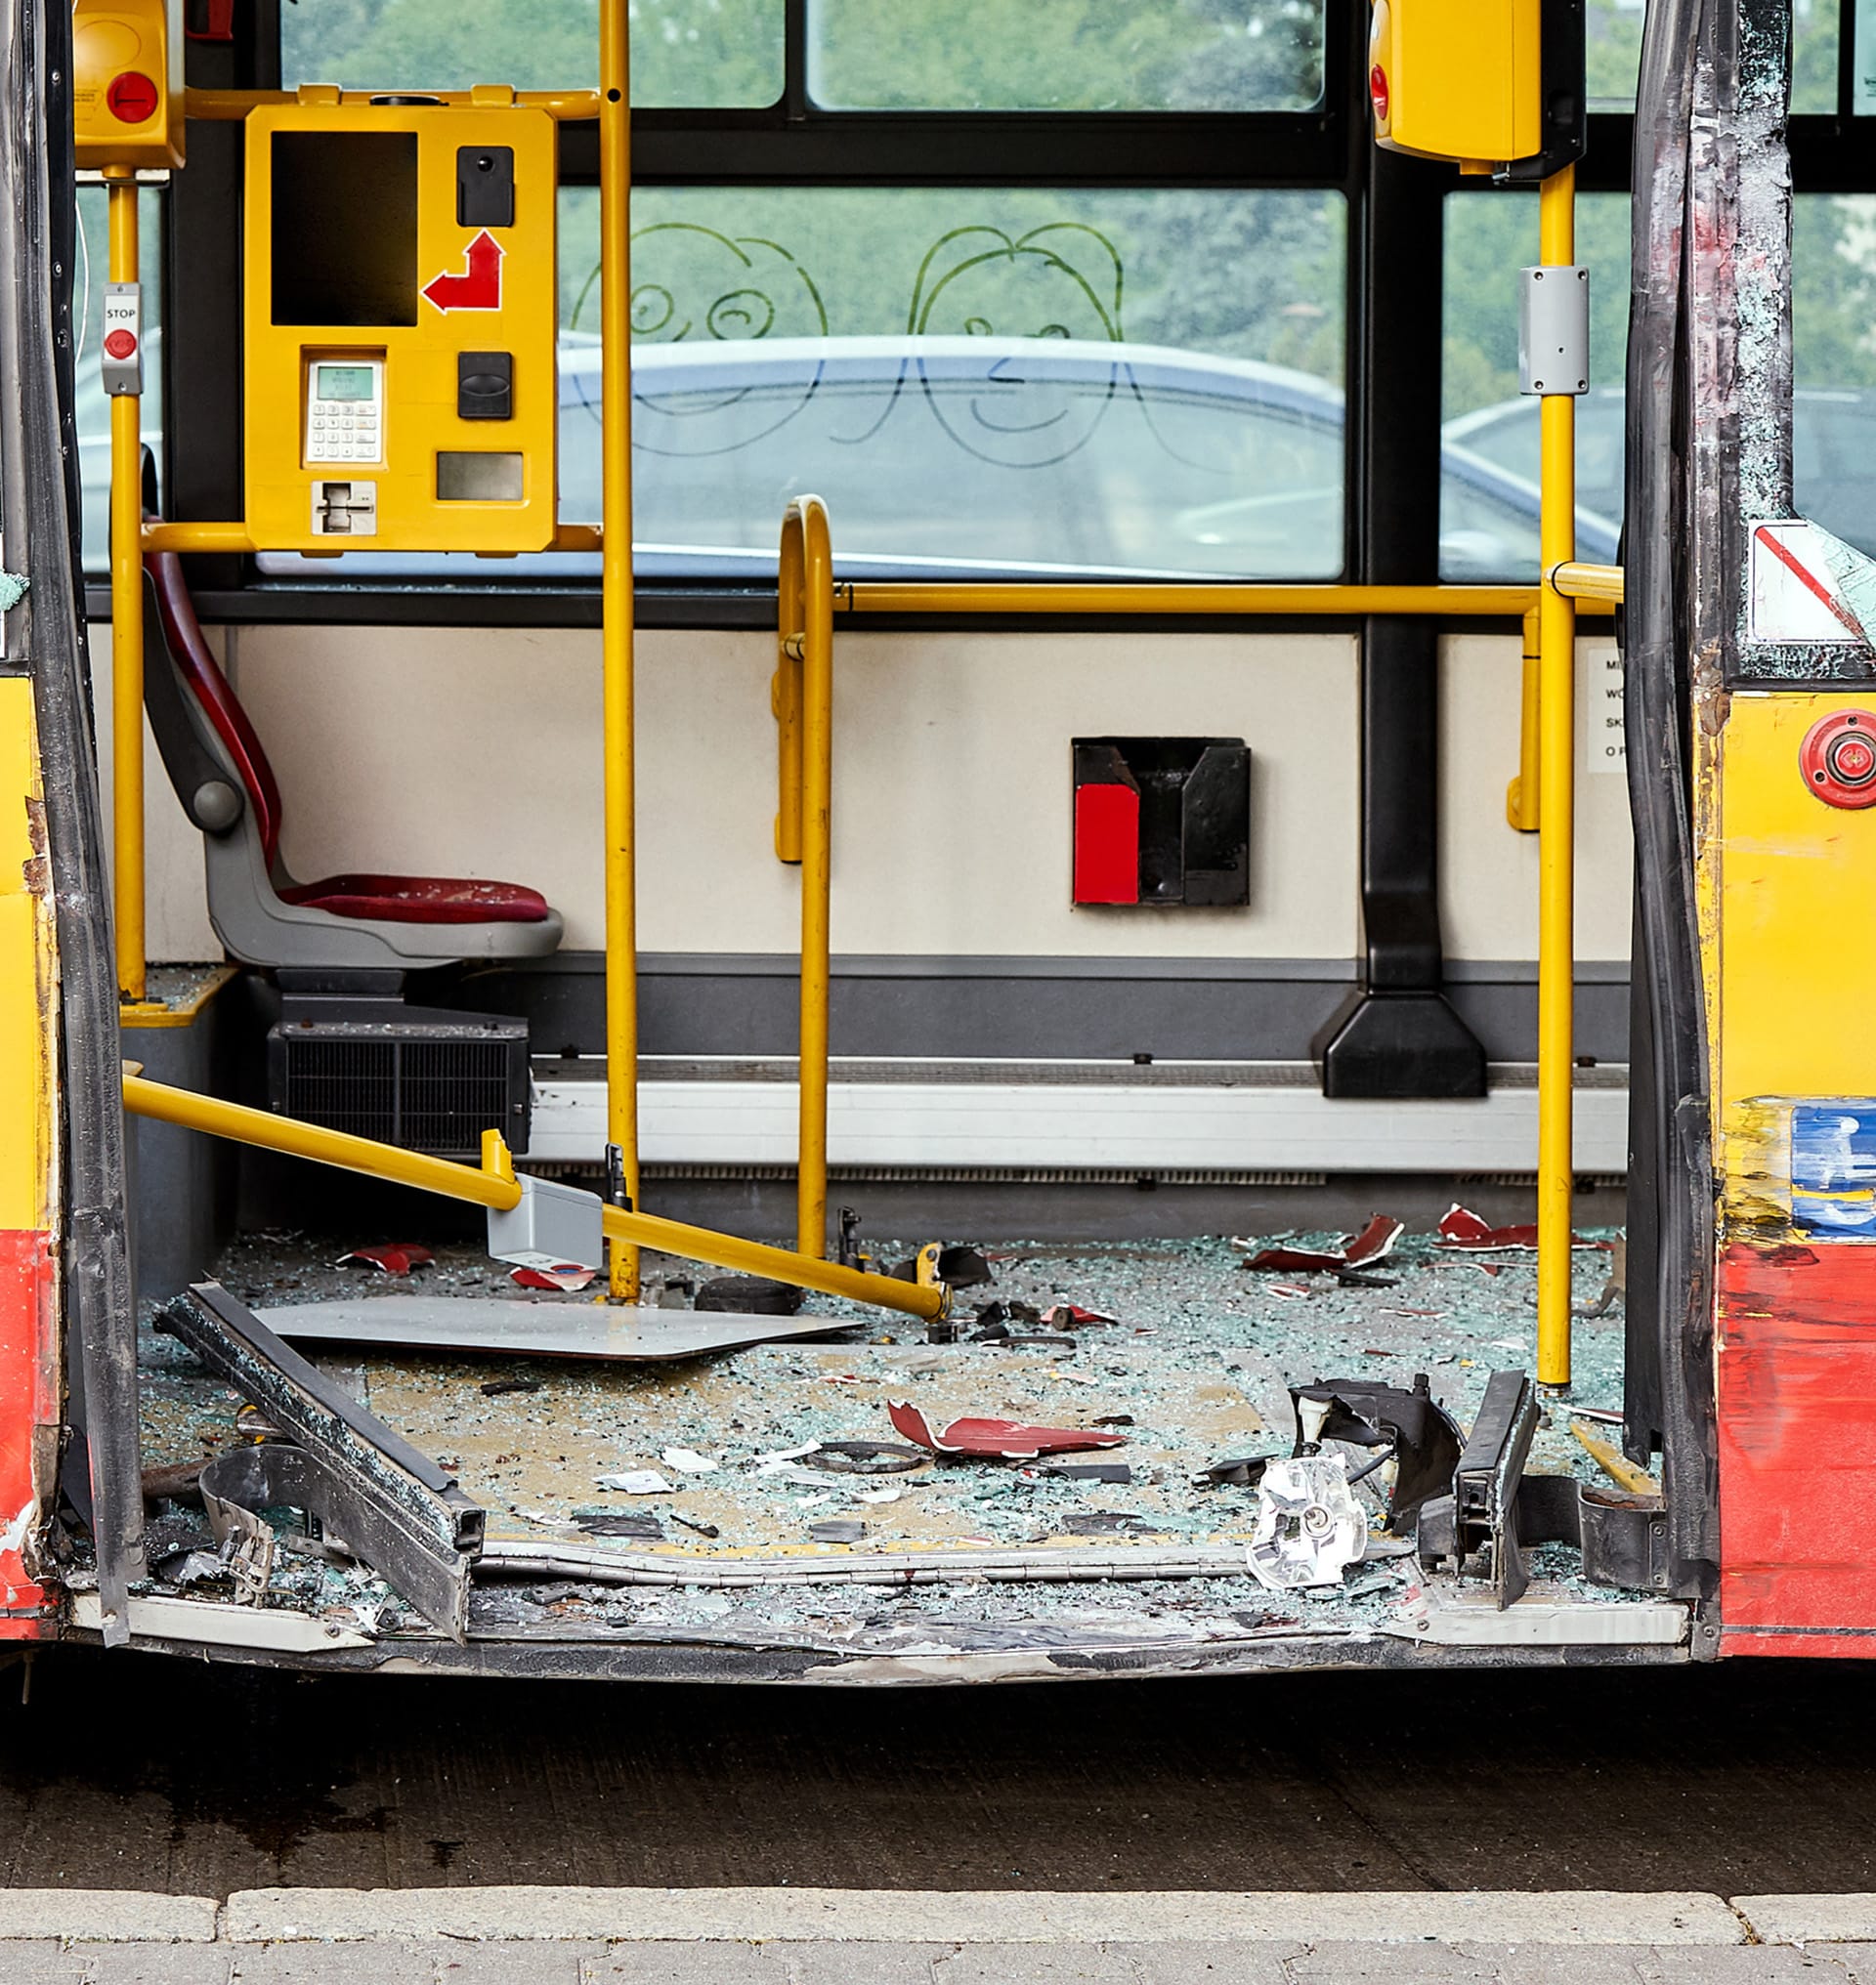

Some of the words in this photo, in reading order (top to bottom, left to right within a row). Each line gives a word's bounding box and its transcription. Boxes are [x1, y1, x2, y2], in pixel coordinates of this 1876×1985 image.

[107, 309, 136, 318] STOP
[1606, 660, 1621, 670] MI
[1605, 718, 1624, 728] SK
